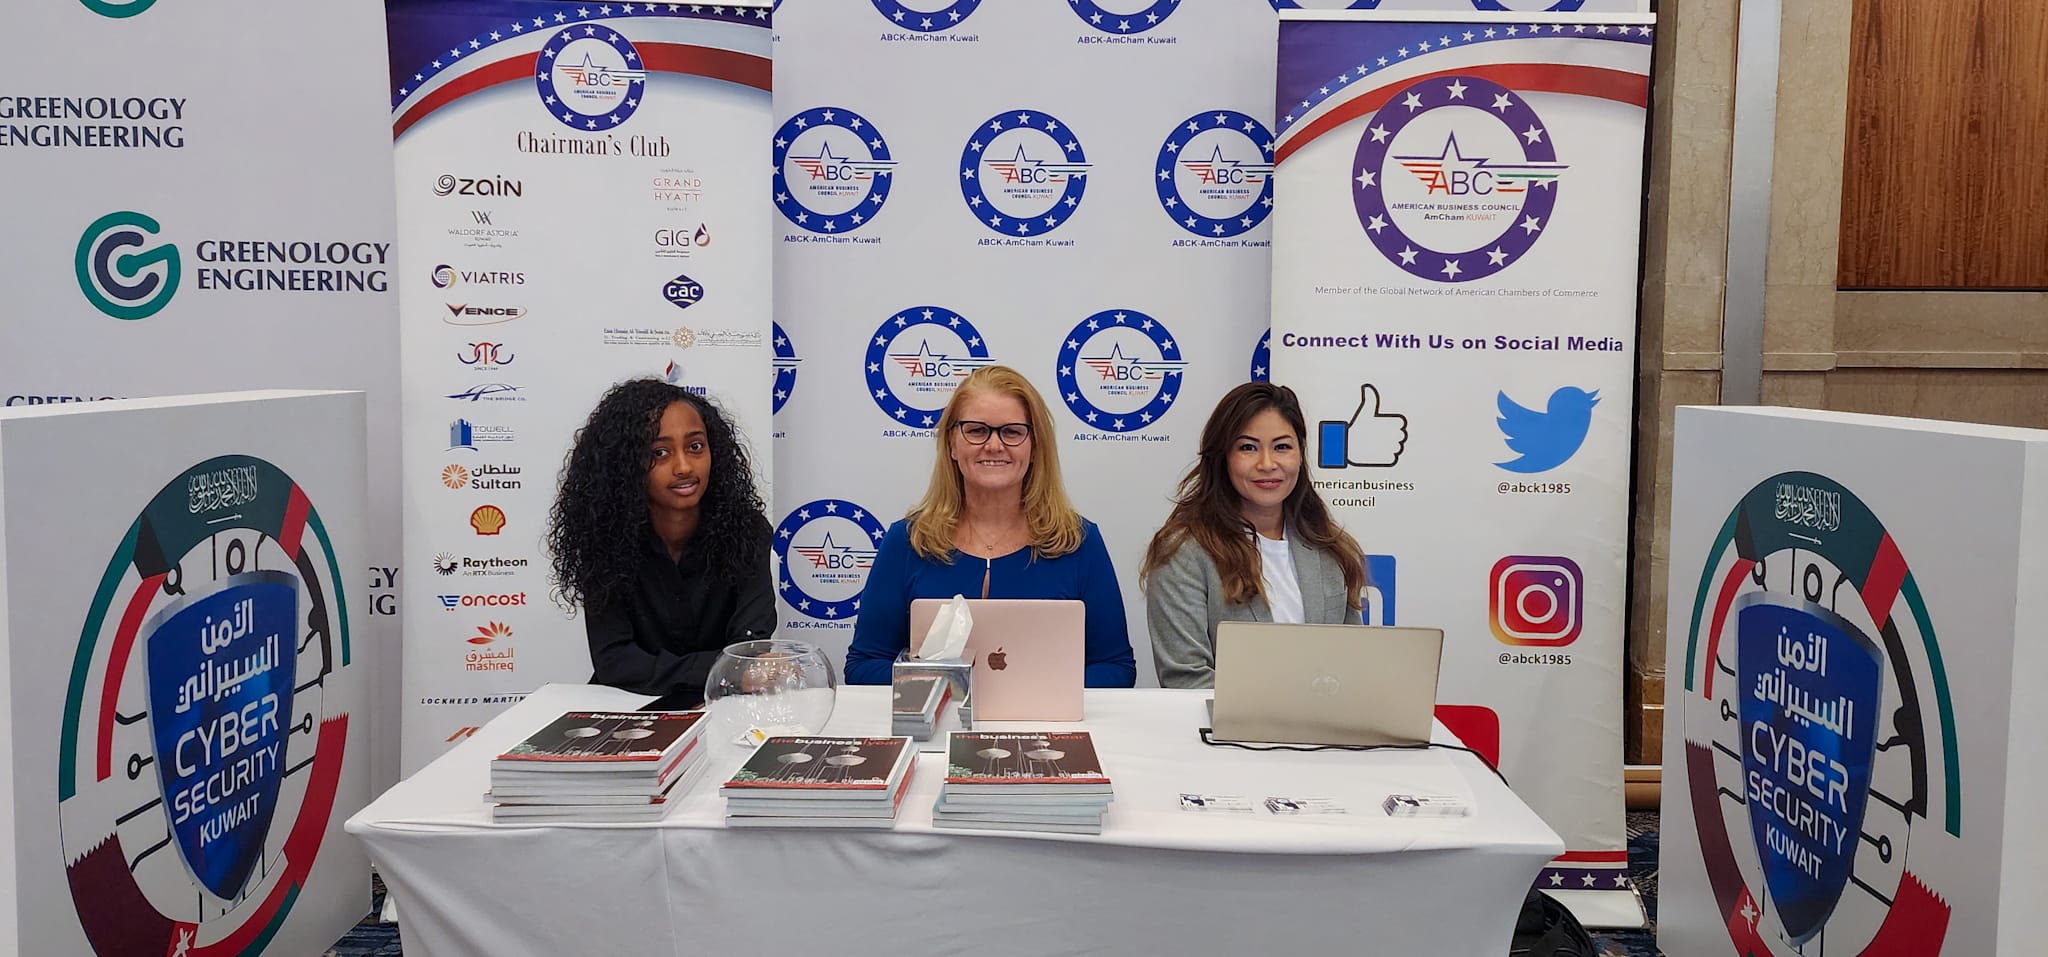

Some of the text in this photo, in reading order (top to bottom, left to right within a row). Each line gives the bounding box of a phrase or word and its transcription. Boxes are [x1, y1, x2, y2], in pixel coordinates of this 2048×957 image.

[880, 33, 979, 42] ABCK-AmCham Kuwait
[1077, 36, 1177, 44] ABCK-AmCham Kuwait
[0, 97, 187, 120] GREENOLOGY
[0, 125, 184, 148] ENGINEERING
[517, 131, 671, 157] Chairman's Club
[458, 174, 522, 198] zain
[653, 178, 702, 188] GRAND
[654, 192, 701, 202] HYATT
[1424, 213, 1497, 221] AmCham KUWAIT
[448, 228, 519, 237] WALDORF ASTORIA
[655, 229, 690, 247] GIG
[784, 235, 881, 244] ABCK-AmCham Kuwait
[978, 238, 1074, 247] ABCK-AmCham Kuwait
[1172, 240, 1271, 248] ABCK-AmCham Kuwait
[196, 241, 390, 264] GREENOLOGY
[197, 269, 388, 292] ENGINEERING
[460, 271, 525, 285] VIATRIS
[1314, 286, 1599, 297] Member of the Global Network of American Chambers of Commerce
[445, 302, 518, 317] VENICE
[1282, 333, 1623, 351] Connect With Us on Social Media
[686, 385, 706, 395] tern
[472, 425, 514, 433] TOWELL
[882, 430, 938, 438] ABCK-AmCh
[1073, 434, 1170, 442] ABCK-AmCham Kuwait
[471, 464, 521, 477] سلطان
[471, 479, 521, 490] Sultan
[1311, 479, 1415, 491] mericanbusiness
[1497, 481, 1571, 495] @abck1985
[1332, 496, 1375, 507] council
[463, 557, 528, 569] Raytheon
[461, 592, 526, 607] oncost
[201, 598, 254, 655] الأمن
[786, 621, 851, 629] ABCK-AmCham
[465, 648, 514, 663] المشرق
[1776, 625, 1828, 677] الأمن
[1498, 652, 1572, 666] @abck1985
[175, 633, 280, 714] السيبراني
[466, 660, 514, 673] mashreq
[421, 697, 478, 705] LOCKHEED
[1753, 667, 1854, 740] السيبراني
[175, 692, 279, 778] CYBER
[1751, 719, 1849, 814] CYBER
[174, 740, 280, 825] SECURITY
[199, 792, 260, 848] KUWAIT
[1749, 770, 1848, 856] SECURITY
[1765, 823, 1823, 880] KUWAIT
